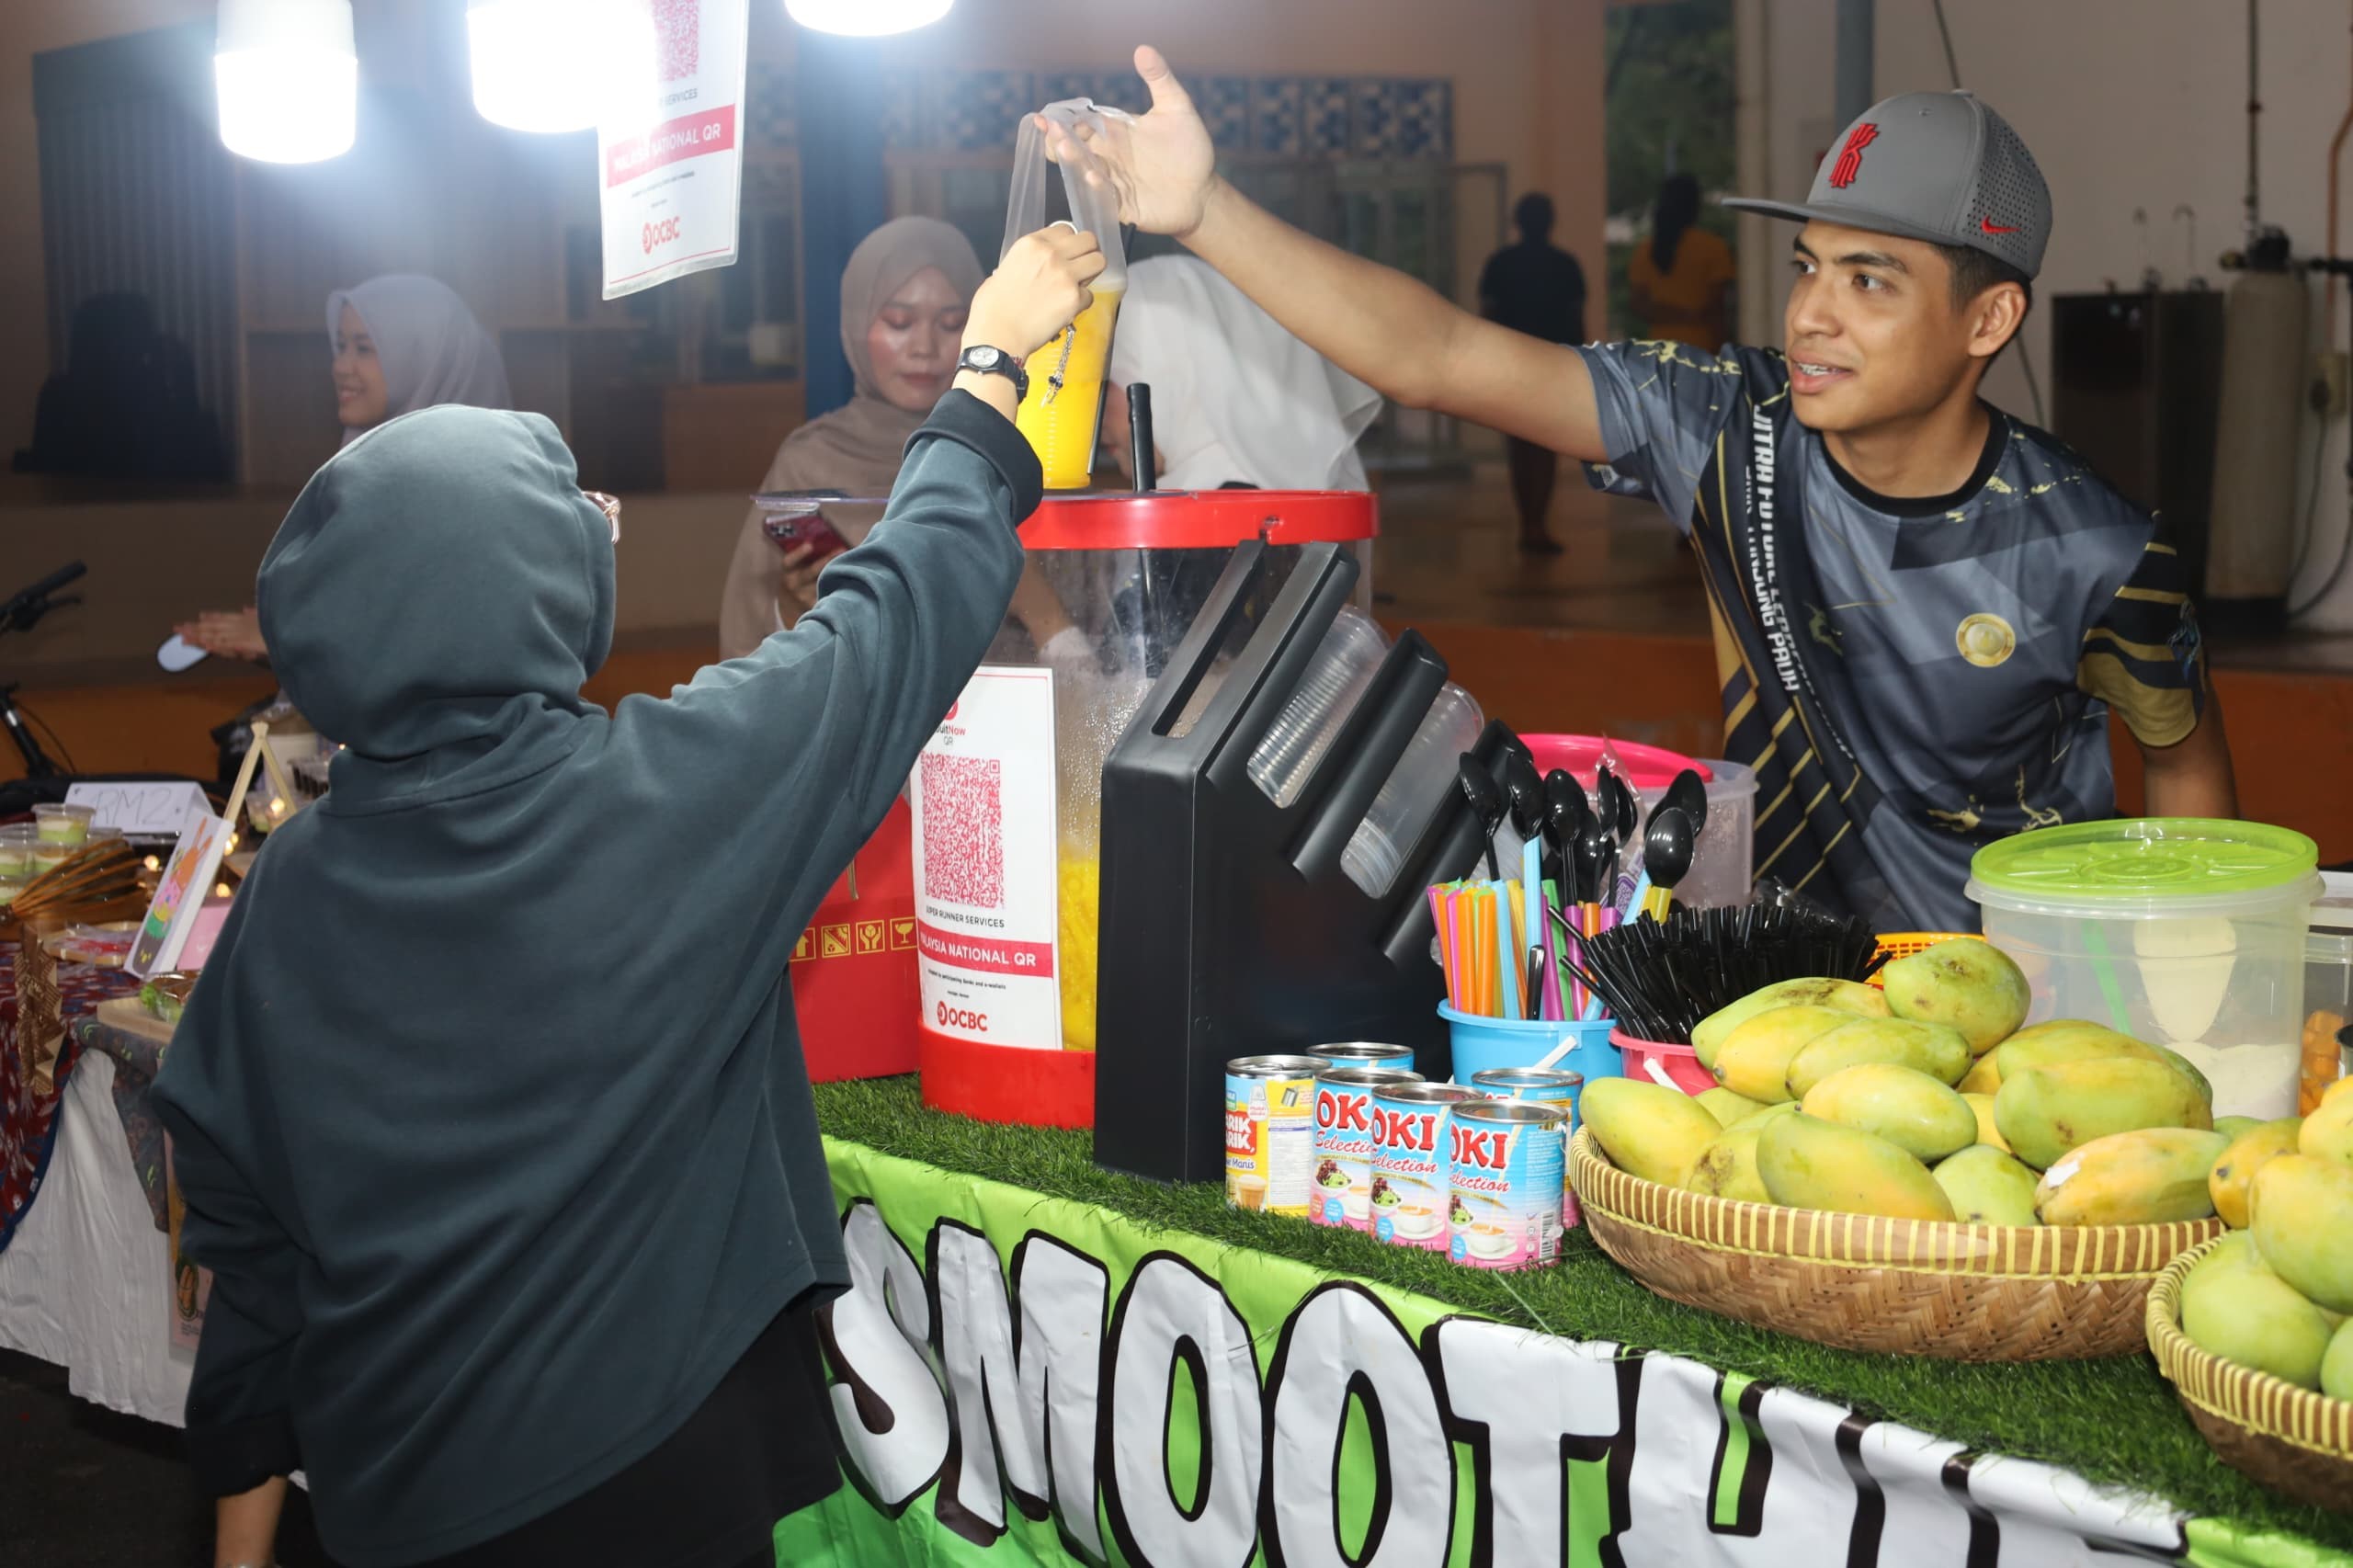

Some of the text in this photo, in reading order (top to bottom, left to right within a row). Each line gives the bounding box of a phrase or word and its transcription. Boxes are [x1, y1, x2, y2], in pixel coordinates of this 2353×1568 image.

[702, 122, 722, 142] QR
[653, 215, 681, 246] OCBC
[1753, 403, 1775, 483] JITRA
[1767, 631, 1801, 691] PAUH
[938, 909, 964, 923] RUNNER
[965, 915, 1006, 928] SERVICES
[948, 941, 1010, 965] NATIONAL
[1013, 951, 1037, 967] QR
[949, 1007, 988, 1032] OCBC
[1316, 1089, 1371, 1132] OK
[1315, 1130, 1372, 1154] Selecti
[1371, 1107, 1436, 1152] OKI
[1232, 1158, 1255, 1169] Manis
